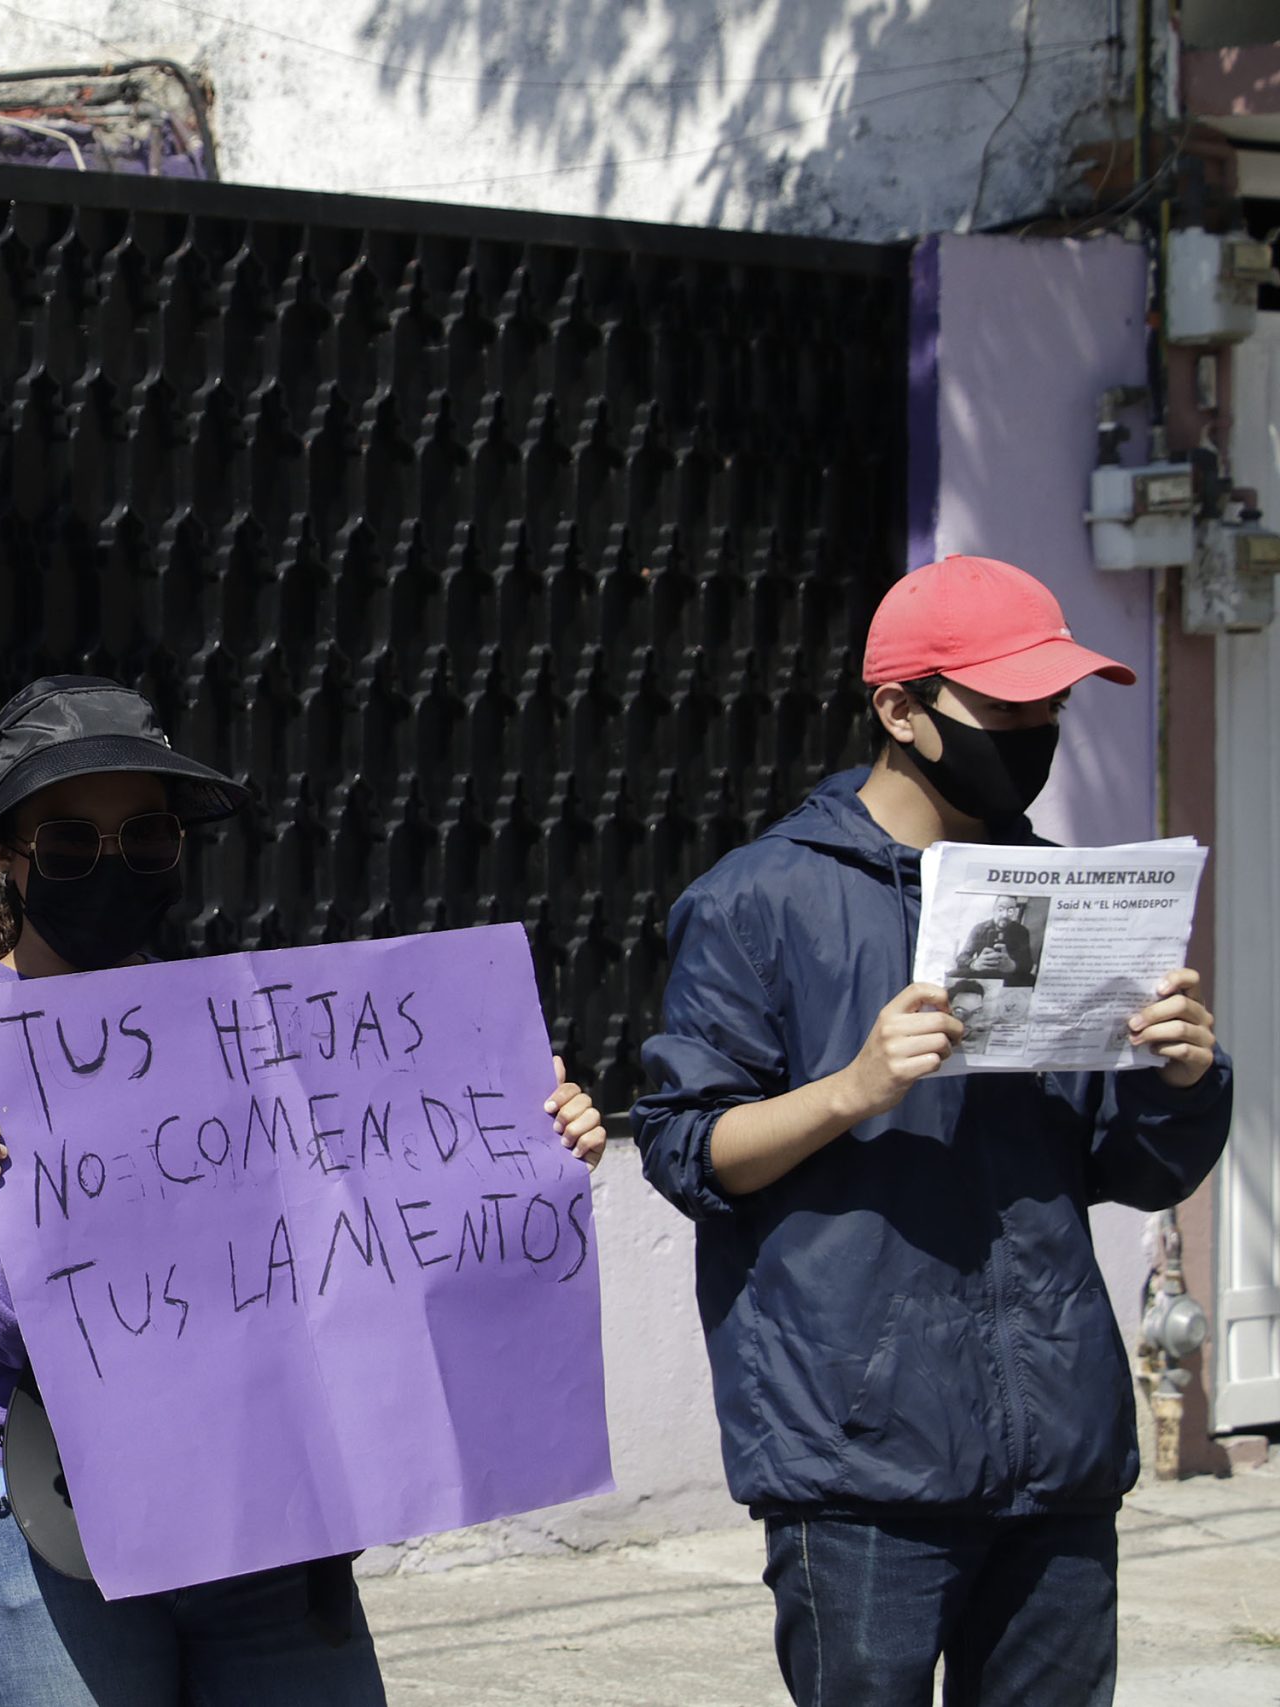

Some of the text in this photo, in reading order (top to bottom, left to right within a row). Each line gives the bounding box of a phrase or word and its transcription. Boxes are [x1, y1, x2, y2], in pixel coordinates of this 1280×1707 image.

[987, 869, 1176, 884] DEUDOR ALIMENTARIO
[1057, 899, 1080, 910] Said
[208, 983, 424, 1084] HIJAS
[33, 1084, 528, 1228] NO COMEN DE
[46, 1191, 588, 1379] TUS LAMENTOS
